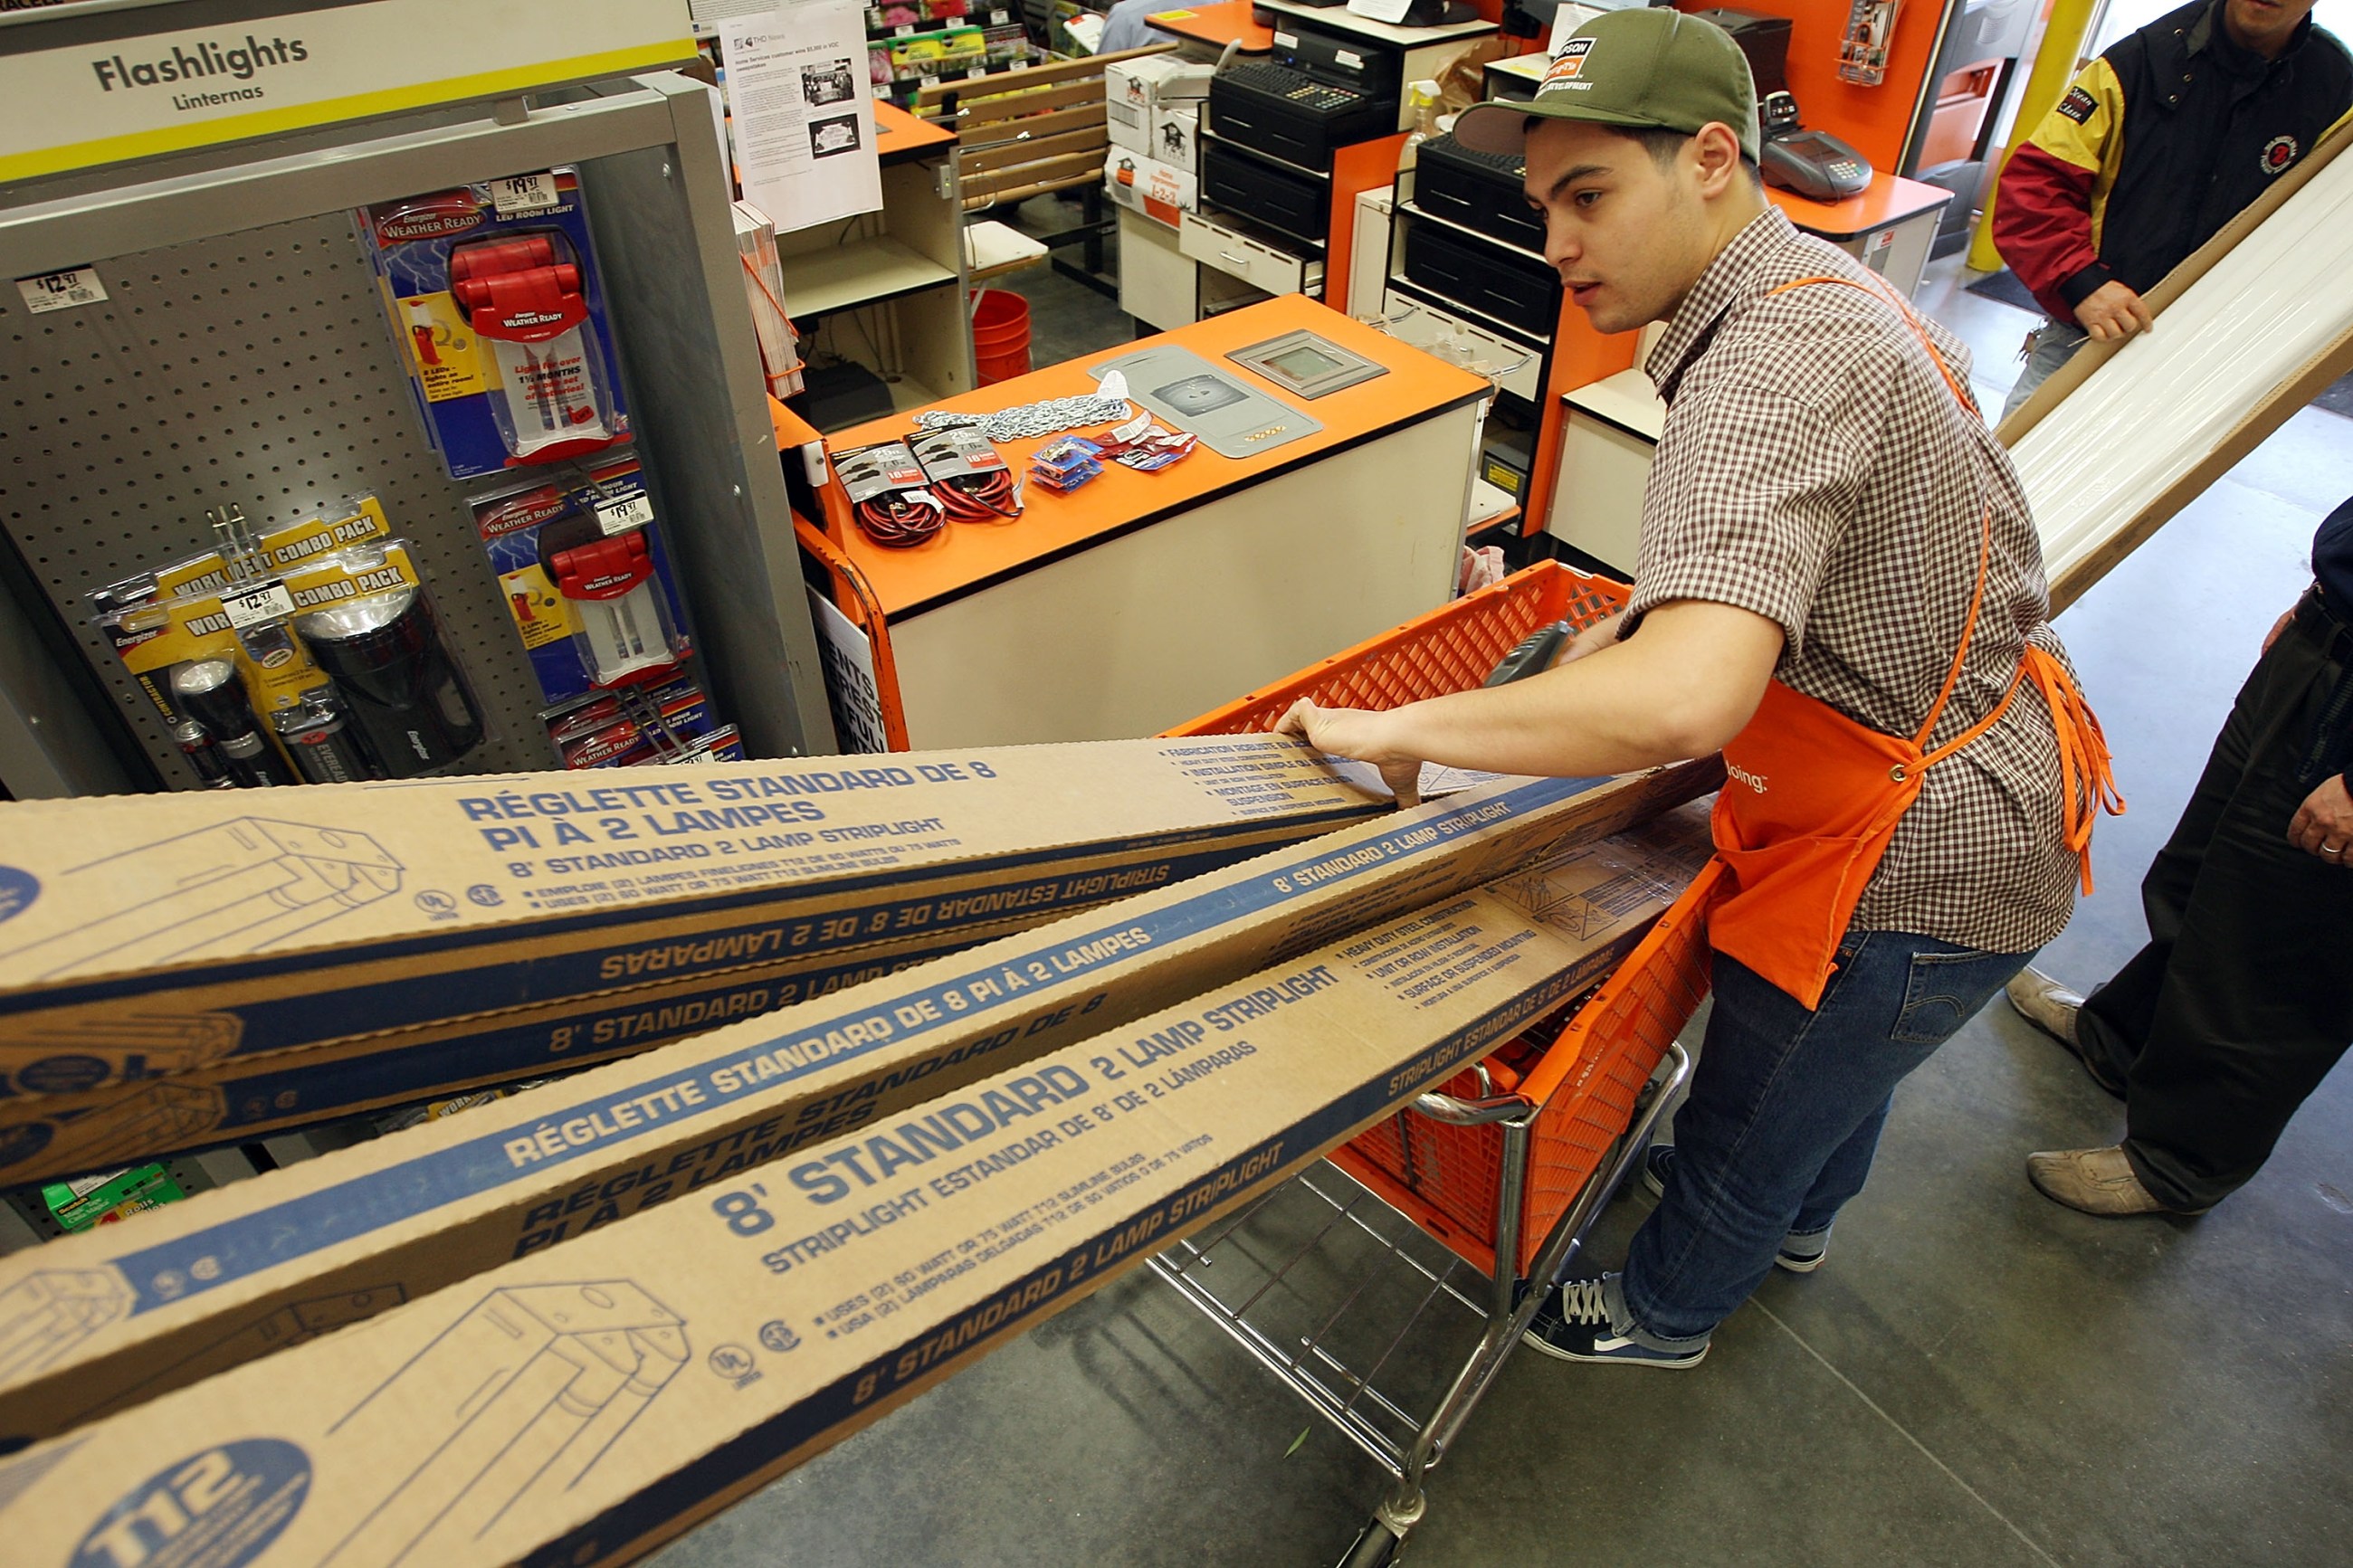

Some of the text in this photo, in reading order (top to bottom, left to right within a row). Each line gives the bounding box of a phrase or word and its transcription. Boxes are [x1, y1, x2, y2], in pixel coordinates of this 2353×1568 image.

[91, 35, 309, 90] Flashlights
[172, 86, 264, 111] Linternas
[384, 214, 483, 239] WEATHER READY
[404, 213, 436, 223] Energizer
[496, 213, 514, 223] LED
[547, 204, 575, 215] LIGHT
[503, 312, 563, 328] WEATHER READY
[537, 366, 582, 381] MONTHS
[559, 356, 582, 367] over
[525, 390, 537, 401] of
[615, 482, 638, 494] LIGHT
[487, 504, 565, 534] WEATHER READY
[501, 508, 529, 521] Energizer
[274, 532, 333, 565] COMBO
[335, 515, 376, 543] PACK
[584, 573, 632, 591] WEATHER READY
[186, 566, 405, 637] WOR COMBO PACK
[115, 629, 158, 648] Energizer
[138, 675, 173, 717] CONTRACTOR
[682, 712, 703, 725] LIGHT
[316, 743, 348, 784] EVEREAD
[407, 730, 430, 760] Energizer
[573, 736, 640, 766] WEATHER READY
[1167, 742, 1279, 757] FABRICATION ROBUSTE
[1189, 764, 1263, 776] INSTALLATION
[1213, 777, 1327, 796] MONTAGE SURFACE
[456, 760, 997, 822] RÉGLETTE STANDARD DE 8
[1226, 792, 1295, 806] SUSPENSION
[480, 801, 827, 852] PI À 2 LAMPES
[507, 817, 947, 878] 8' STANDARD 2 LAMP STRIPLIGHT
[1272, 875, 1294, 893] 8'
[1291, 846, 1385, 889] STANDARD
[1380, 840, 1401, 856] 2
[1396, 825, 1439, 851] LAMP
[1439, 801, 1512, 835] STRIPLIGHT
[635, 855, 827, 886] LAMPES DE
[643, 860, 860, 896] WATT WATT SLIMLINE
[599, 863, 1172, 982] STRIPLIGHT ESTANDAR DE 8' DE 2 LÁMPARAS
[1343, 898, 1478, 958] HEAVY DUTY STEEL CONSTRUCTION
[1372, 924, 1483, 979] UNIT OR ROW INSTALLATION
[1403, 929, 1538, 1000] SURFACE OR SUSPENDED MOUNTING
[548, 962, 884, 1053] 8' STANDARD 2 LAMP
[503, 927, 1153, 1170] RÉGLETTE STANDARD DE 8 PI À 2 LAMPES
[1387, 974, 1572, 1098] STRIPLIGHT ESTANDAR DE DE 2
[523, 991, 1110, 1232] RÉGLETTE STANDARD DE 8
[710, 964, 1340, 1239] 8' STANDARD 2 LAMP STRIPLIGHT
[760, 1039, 1258, 1274] STRIPLIGHT ESTANDAR DE 8' DE 2 LÁMPARAS
[510, 1101, 877, 1260] PI 2 LAMPES
[58, 1196, 89, 1215] Scotch
[125, 1198, 155, 1216] Rolls
[824, 1153, 1147, 1322] USES WATT OR 75 WATT T12 SLIMLINE BULBS
[838, 1133, 1215, 1335] USA DELGADAS T12 DE VATIOS VATIOS
[852, 1142, 1286, 1406] 8' STANDARD 2 LAMP STRIPLIGHT
[83, 1449, 245, 1567] T12
